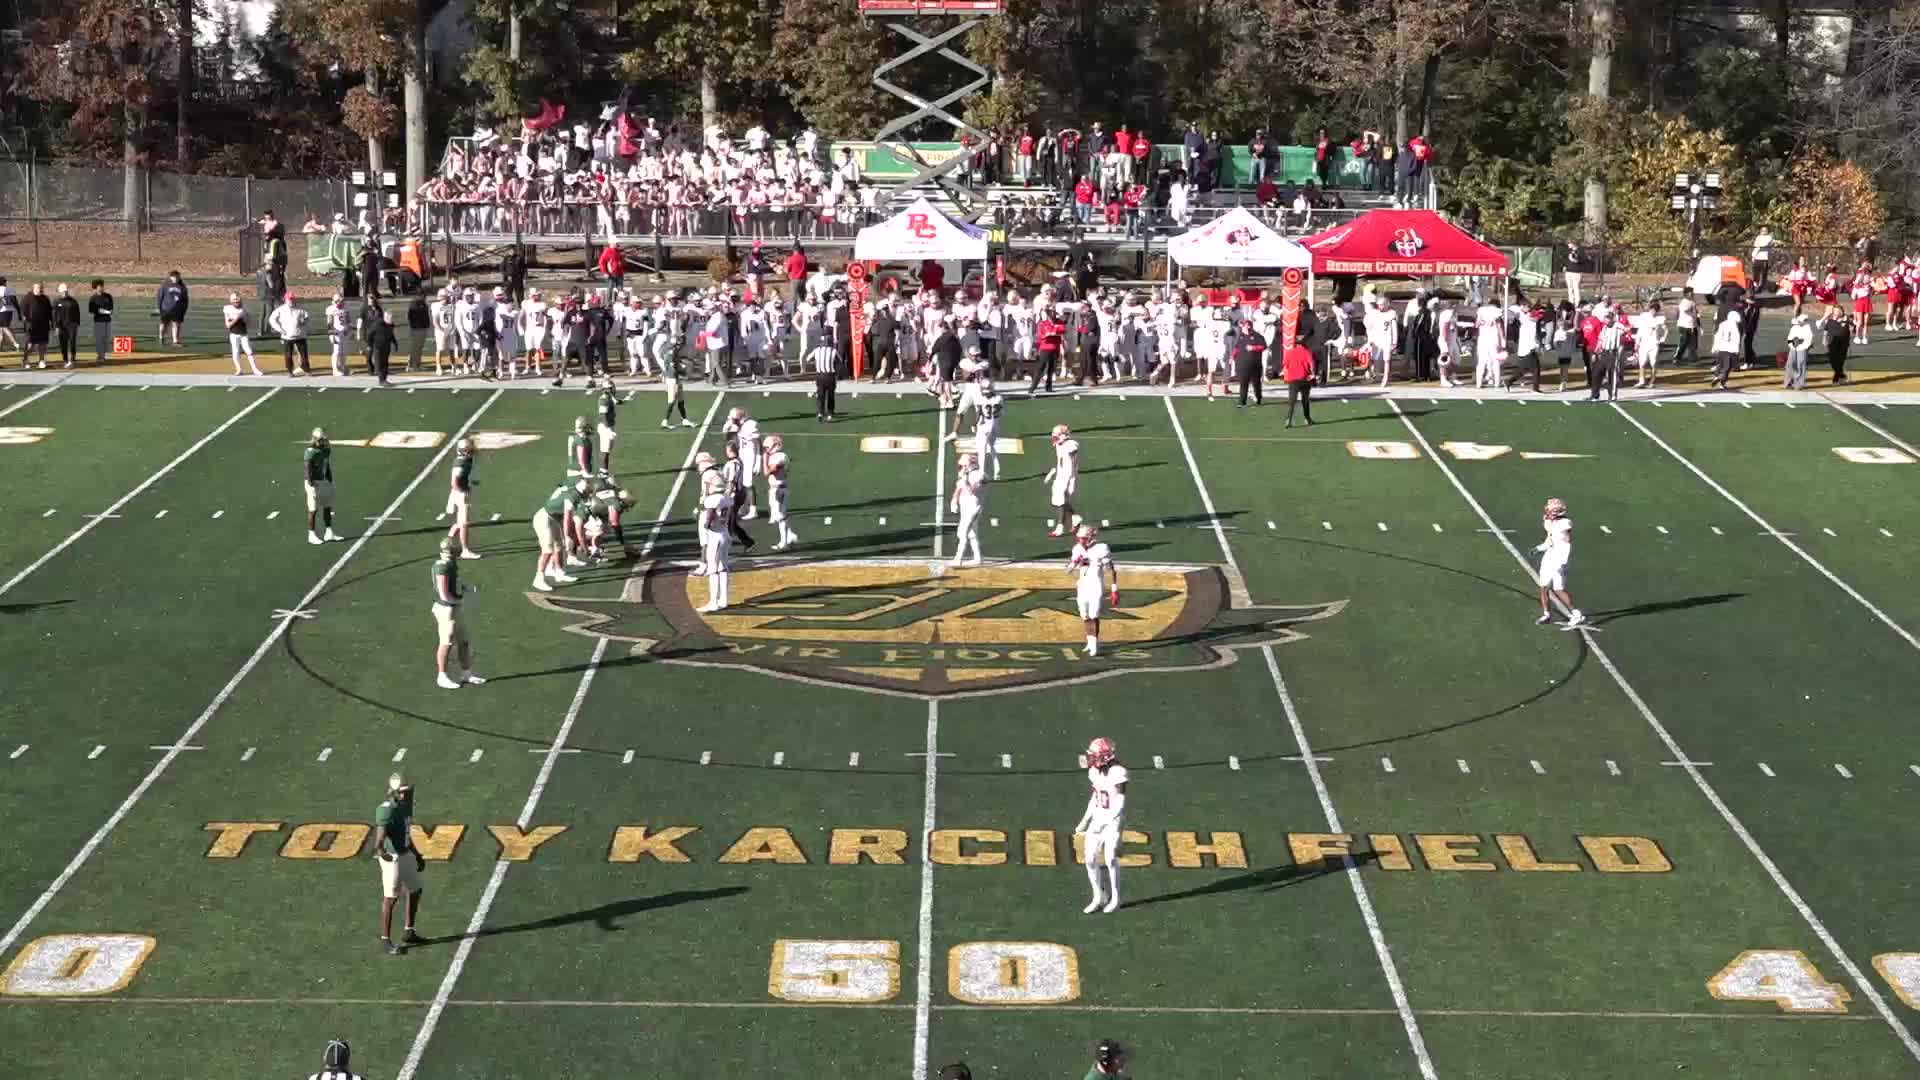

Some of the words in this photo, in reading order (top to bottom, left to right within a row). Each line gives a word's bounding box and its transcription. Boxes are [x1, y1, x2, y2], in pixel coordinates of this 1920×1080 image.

[1376, 262, 1432, 273] CATHOLIC
[1436, 262, 1495, 273] FOOTBALL
[204, 822, 568, 863] TONY
[608, 826, 1251, 870] KARCICH
[1286, 832, 1672, 874] FIELD
